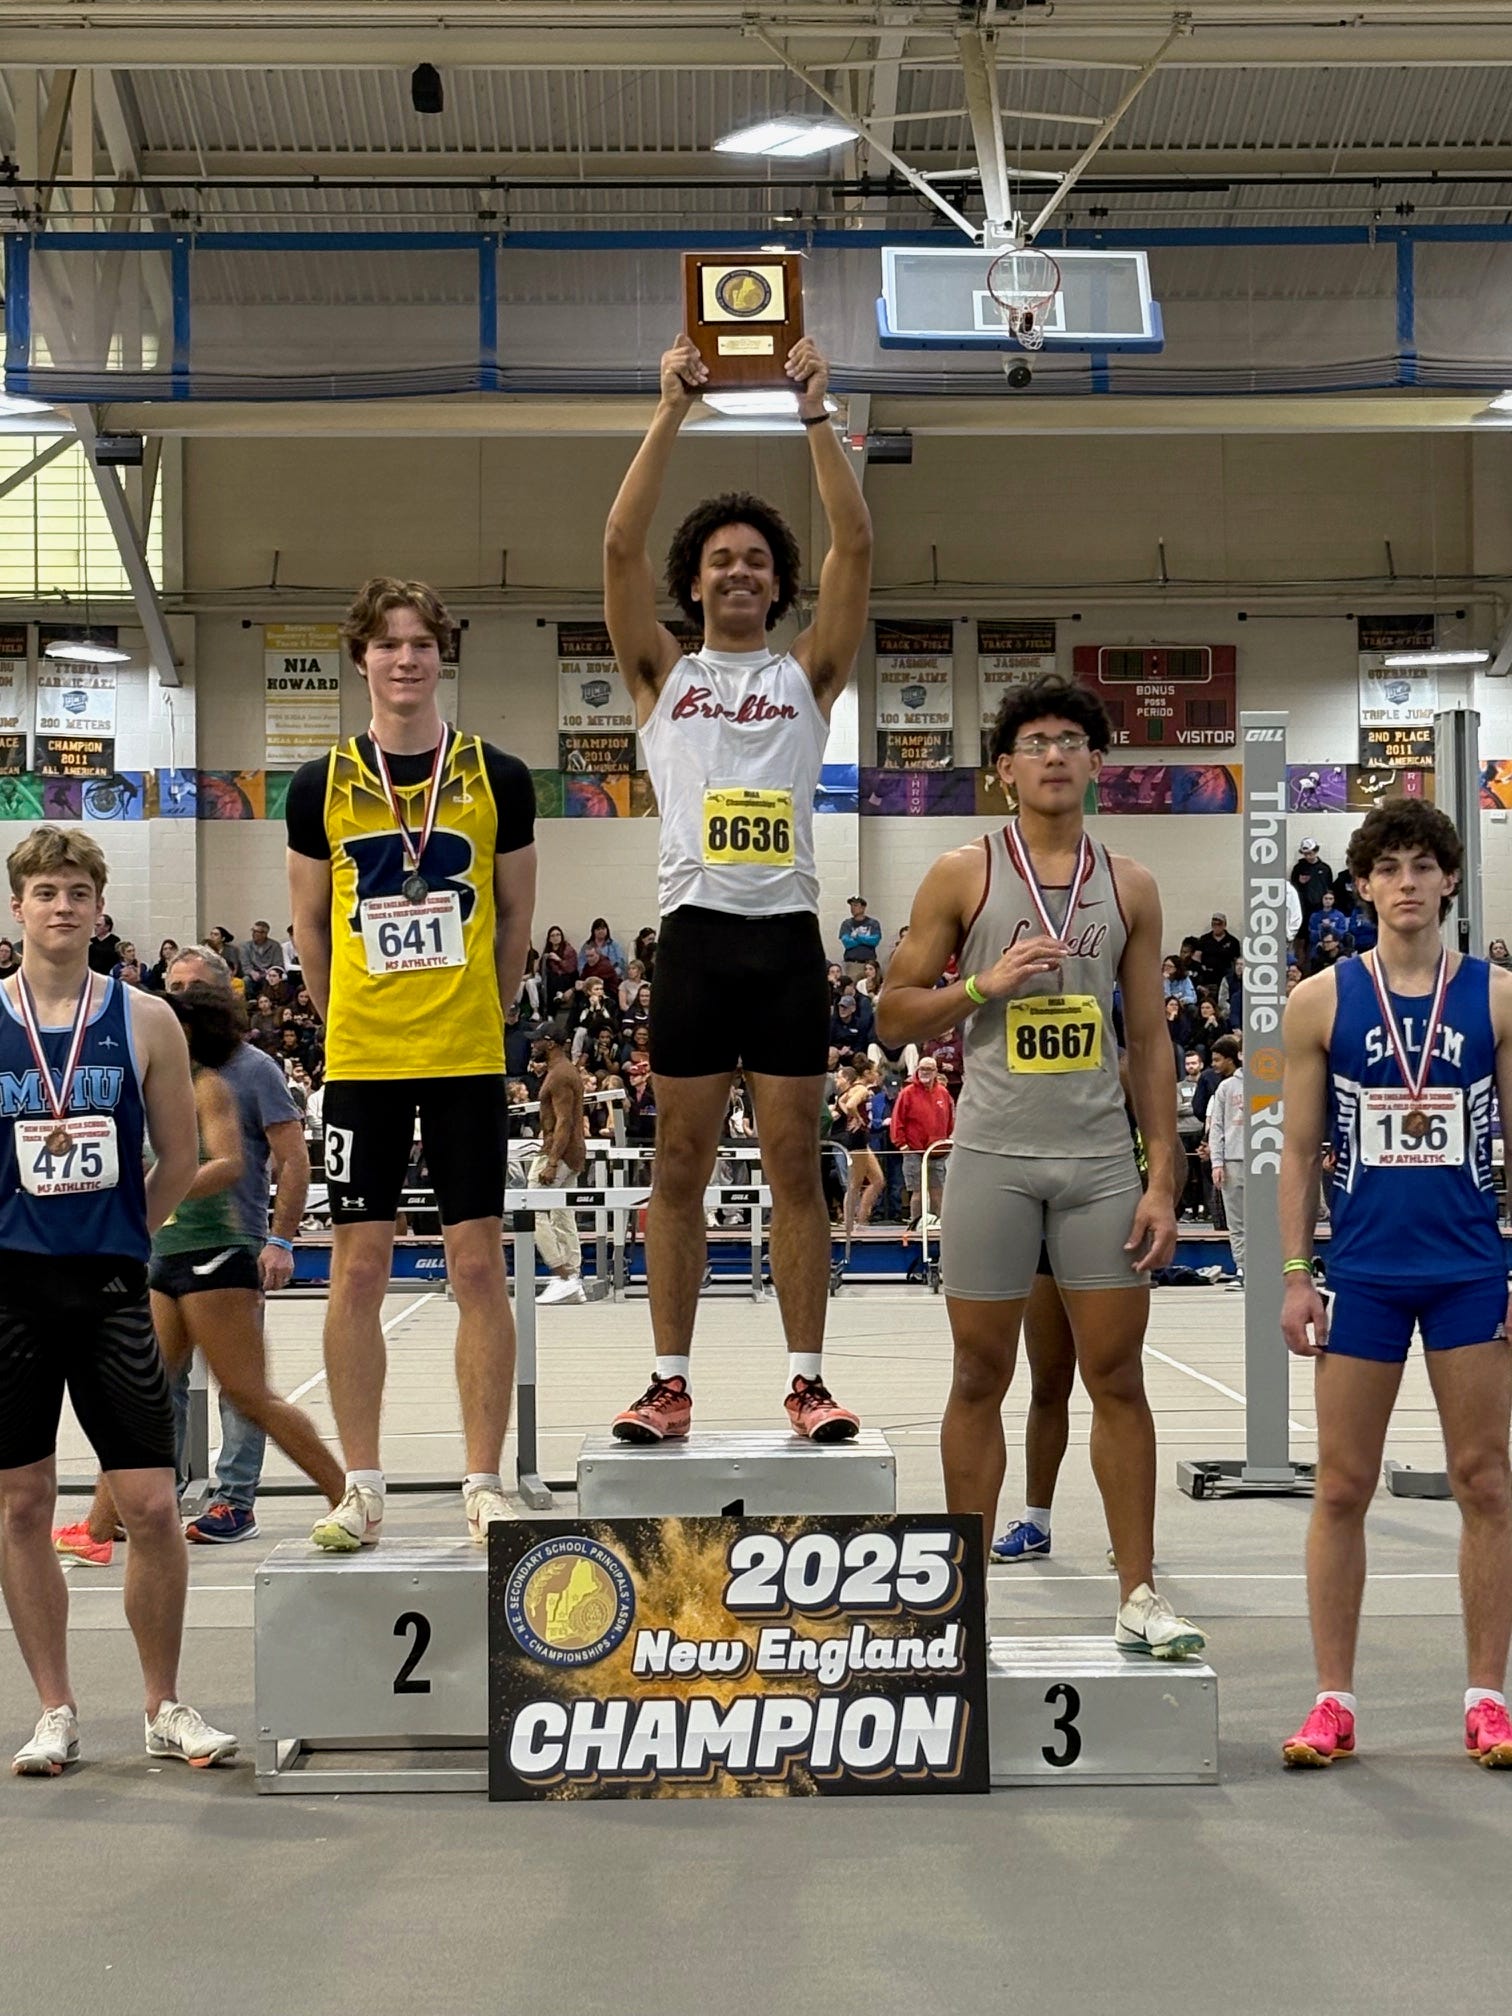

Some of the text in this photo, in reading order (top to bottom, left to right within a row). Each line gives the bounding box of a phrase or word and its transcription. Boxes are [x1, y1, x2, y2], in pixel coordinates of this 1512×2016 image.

[284, 658, 321, 672] NIA
[561, 662, 619, 673] NIA HOWA
[267, 678, 338, 690] HOWARD
[1136, 685, 1175, 695] BONUS
[1144, 698, 1166, 706] POSS
[880, 712, 949, 724] 100 METERS
[1137, 707, 1174, 716] PERIOD
[1362, 709, 1434, 720] TRIPLE JUMP
[40, 717, 111, 730] 200 METERS
[563, 715, 632, 726] 100 METERS
[888, 735, 941, 746] CHAMPION
[1176, 730, 1235, 744] VISITOR
[1245, 729, 1284, 742] GILL
[1368, 730, 1430, 742] 2ND PLACE
[48, 740, 103, 753] CHAMPION
[566, 738, 629, 748] CHAMPION
[1385, 744, 1412, 755] 2011
[61, 753, 88, 765] 2011
[584, 751, 611, 762] 2010
[901, 748, 928, 758] 2012
[1388, 756, 1432, 765] AMERICAN
[42, 765, 107, 776] ALL AMERICAN
[1250, 781, 1287, 864] The
[708, 816, 790, 853] 8636
[378, 917, 443, 958] 641
[1002, 919, 1109, 959] Lell
[1243, 877, 1287, 1033] Reggie
[401, 956, 448, 969] ATHLETIC
[1016, 1022, 1096, 1060] 8667
[326, 1130, 345, 1177] 3
[1396, 1154, 1446, 1164] ATHLETIC
[33, 1142, 103, 1179] 475
[53, 1181, 101, 1193] ATHLETIC
[415, 1258, 445, 1269] GILL
[510, 1551, 543, 1609] SECONDARY
[545, 1542, 587, 1556] SCHOOL
[726, 1531, 954, 1607] 2025
[392, 1612, 432, 1695] 2
[529, 1639, 611, 1663] CHAMPIONSHIPS
[632, 1623, 958, 1686] New England
[1041, 1682, 1082, 1768] 3
[510, 1695, 957, 1774] CHAMPION
